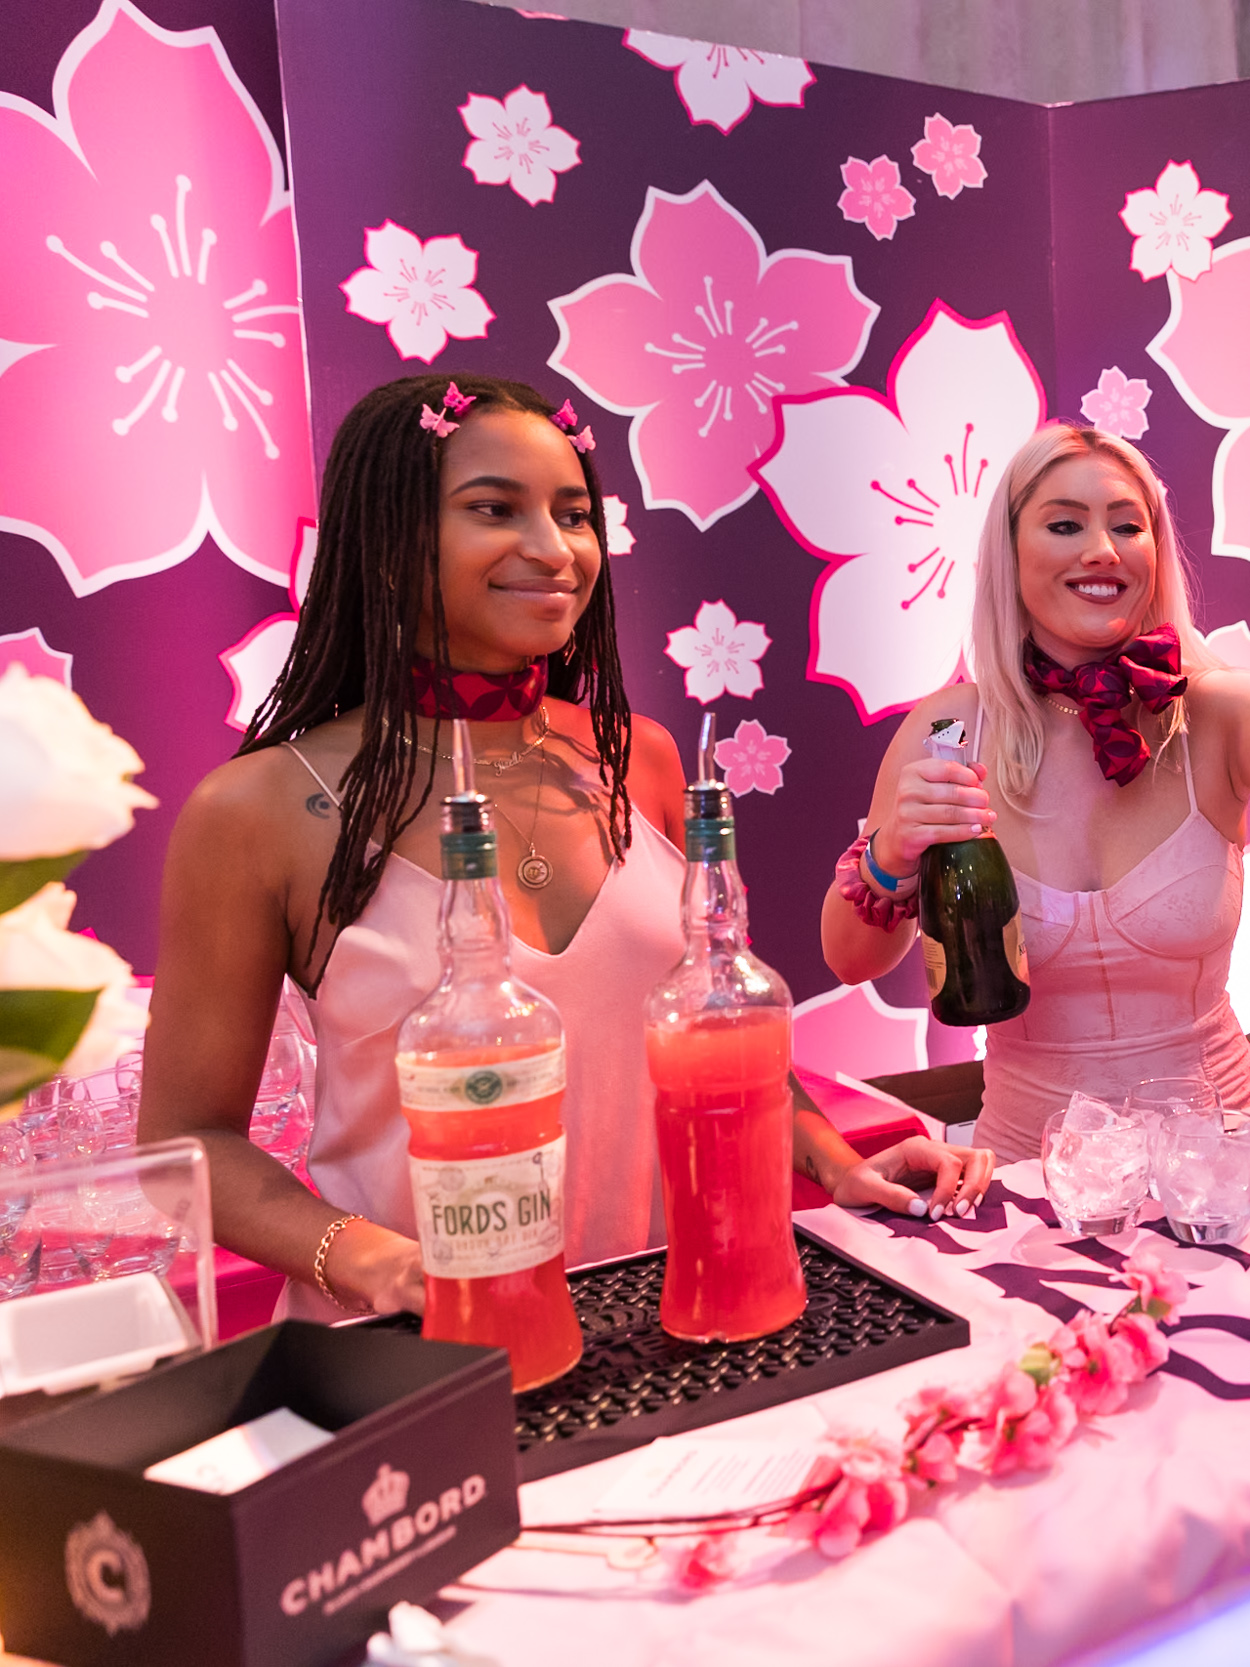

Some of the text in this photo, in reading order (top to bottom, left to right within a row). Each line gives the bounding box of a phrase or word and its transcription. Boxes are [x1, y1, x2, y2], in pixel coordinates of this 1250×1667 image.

[432, 1188, 551, 1236] FORDS GIN
[280, 1473, 486, 1616] CHAMBORD
